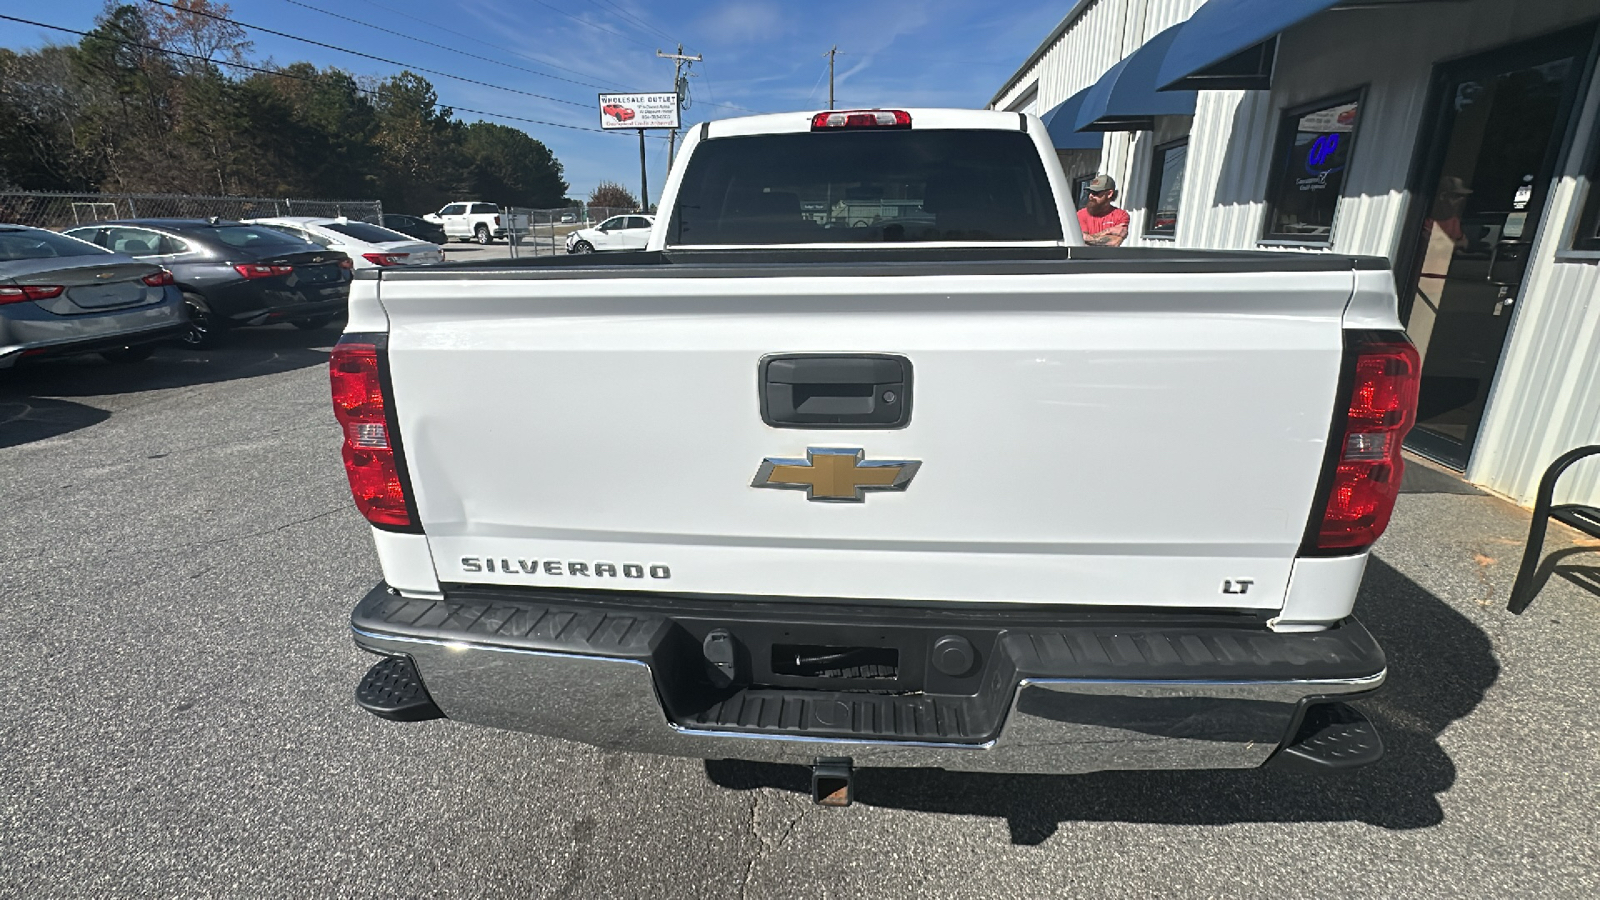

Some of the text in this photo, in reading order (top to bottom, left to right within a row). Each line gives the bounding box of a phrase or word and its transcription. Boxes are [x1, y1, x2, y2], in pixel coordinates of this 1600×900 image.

[601, 96, 645, 104] WHOLESALE
[461, 556, 671, 579] SILVERADO
[1222, 579, 1254, 595] LT
